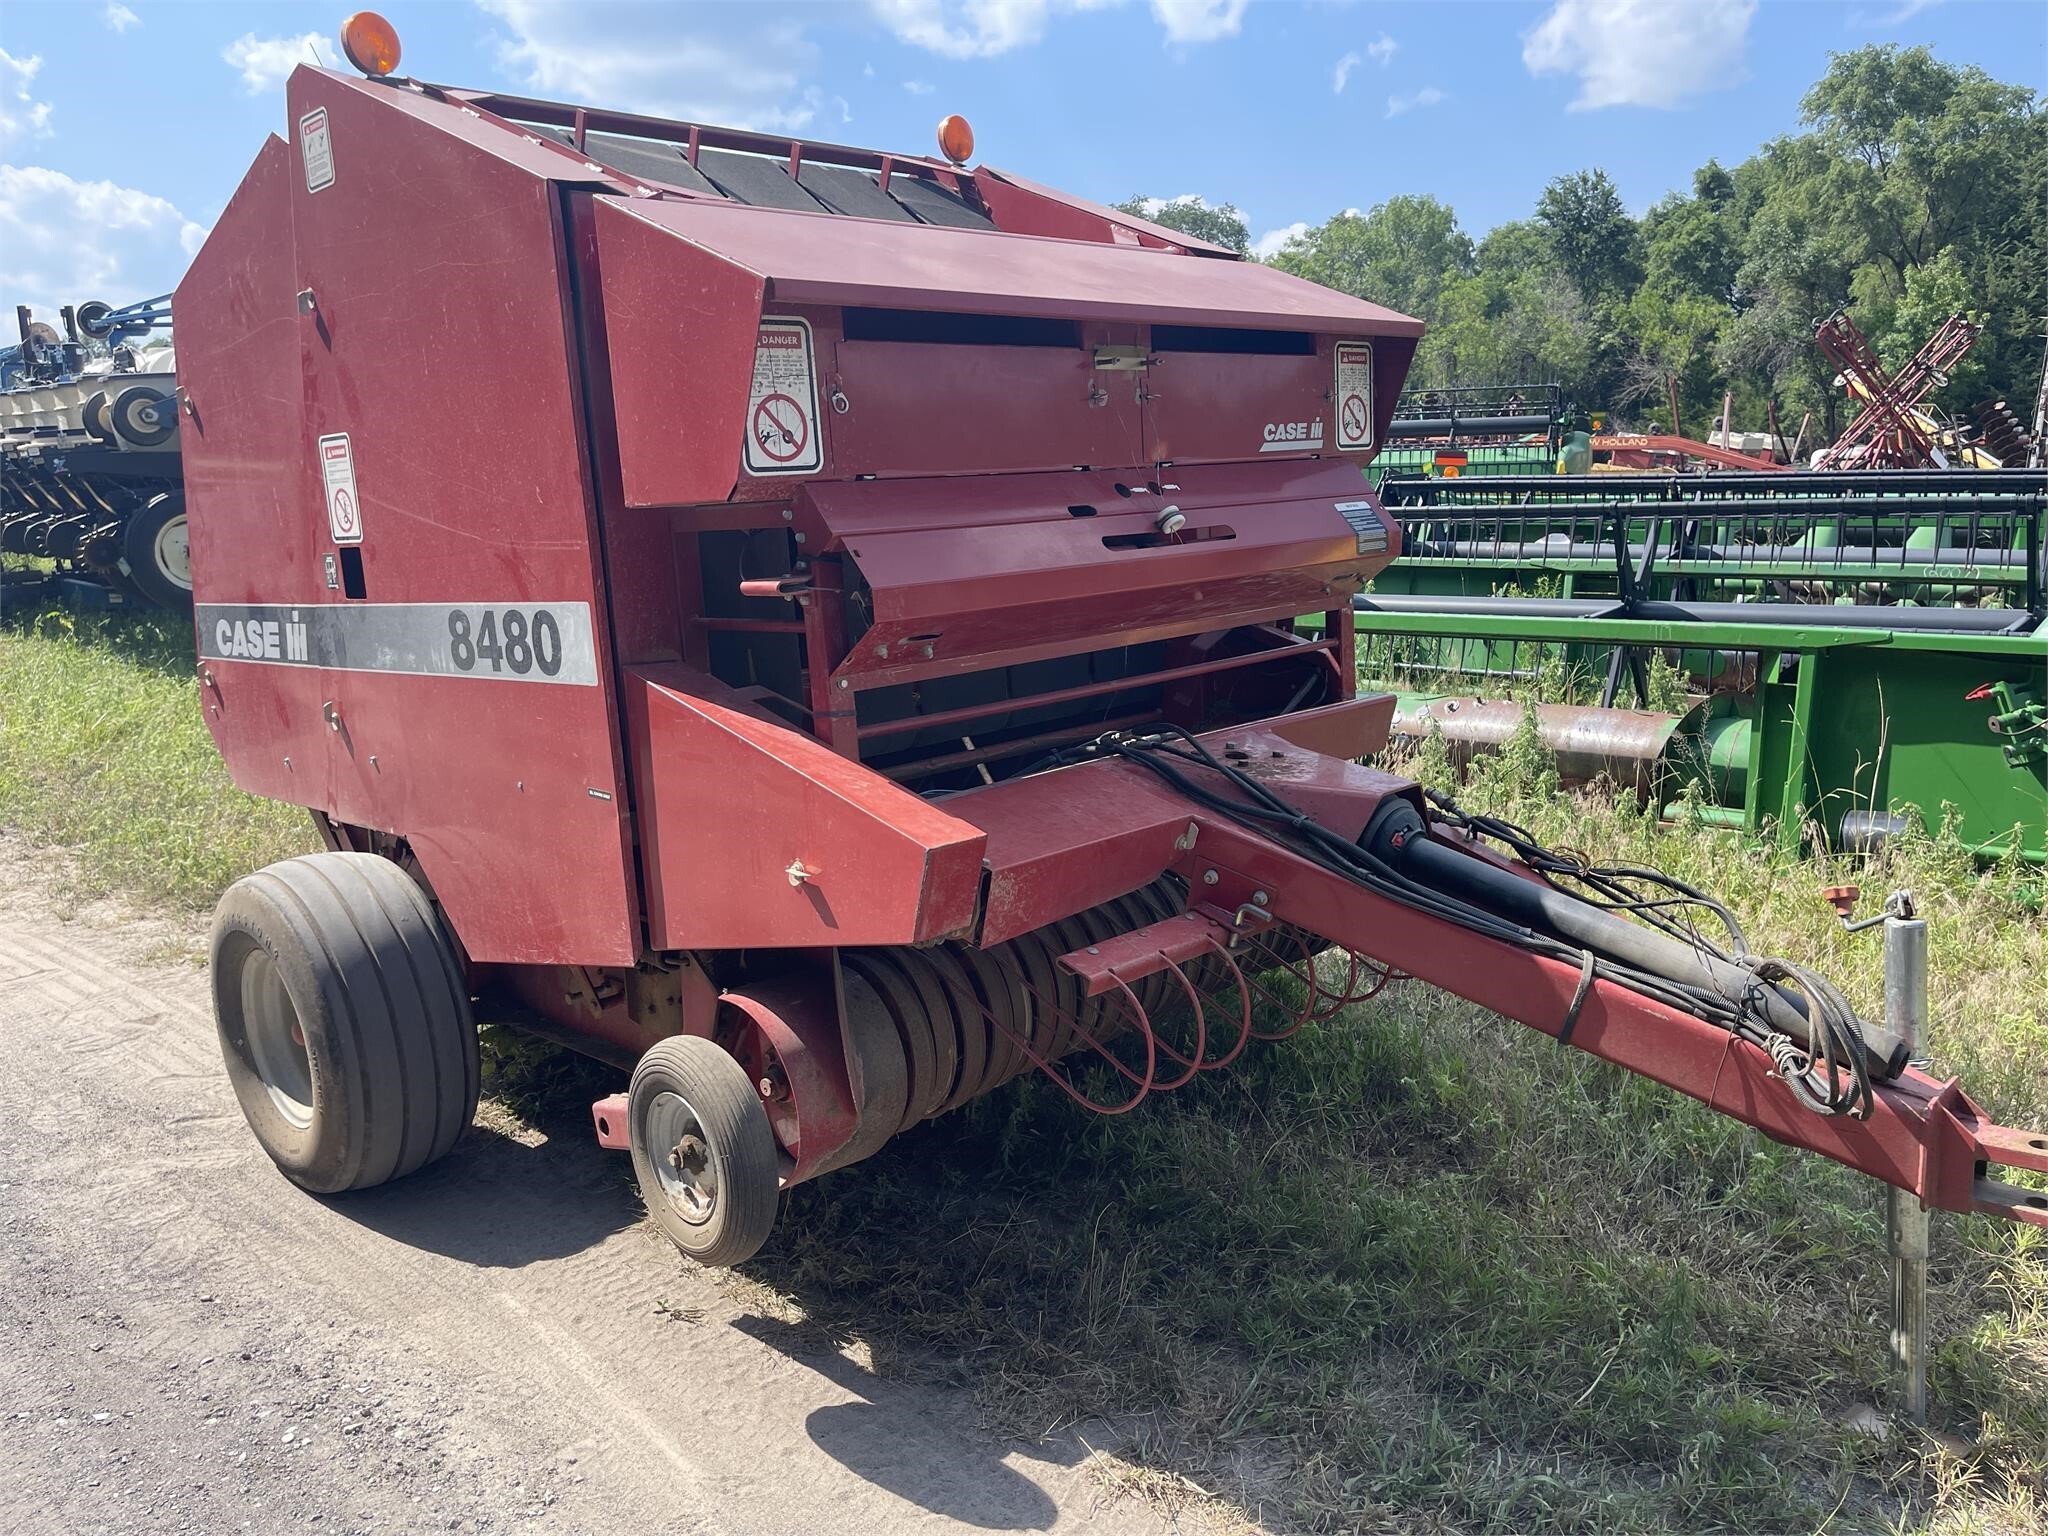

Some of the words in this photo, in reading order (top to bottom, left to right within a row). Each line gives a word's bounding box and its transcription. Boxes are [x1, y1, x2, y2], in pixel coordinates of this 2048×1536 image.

[762, 335, 798, 345] DANGER
[1263, 422, 1308, 441] CASE
[1602, 438, 1648, 446] HOLLAND
[216, 618, 281, 659] CASE
[448, 608, 562, 677] 8480
